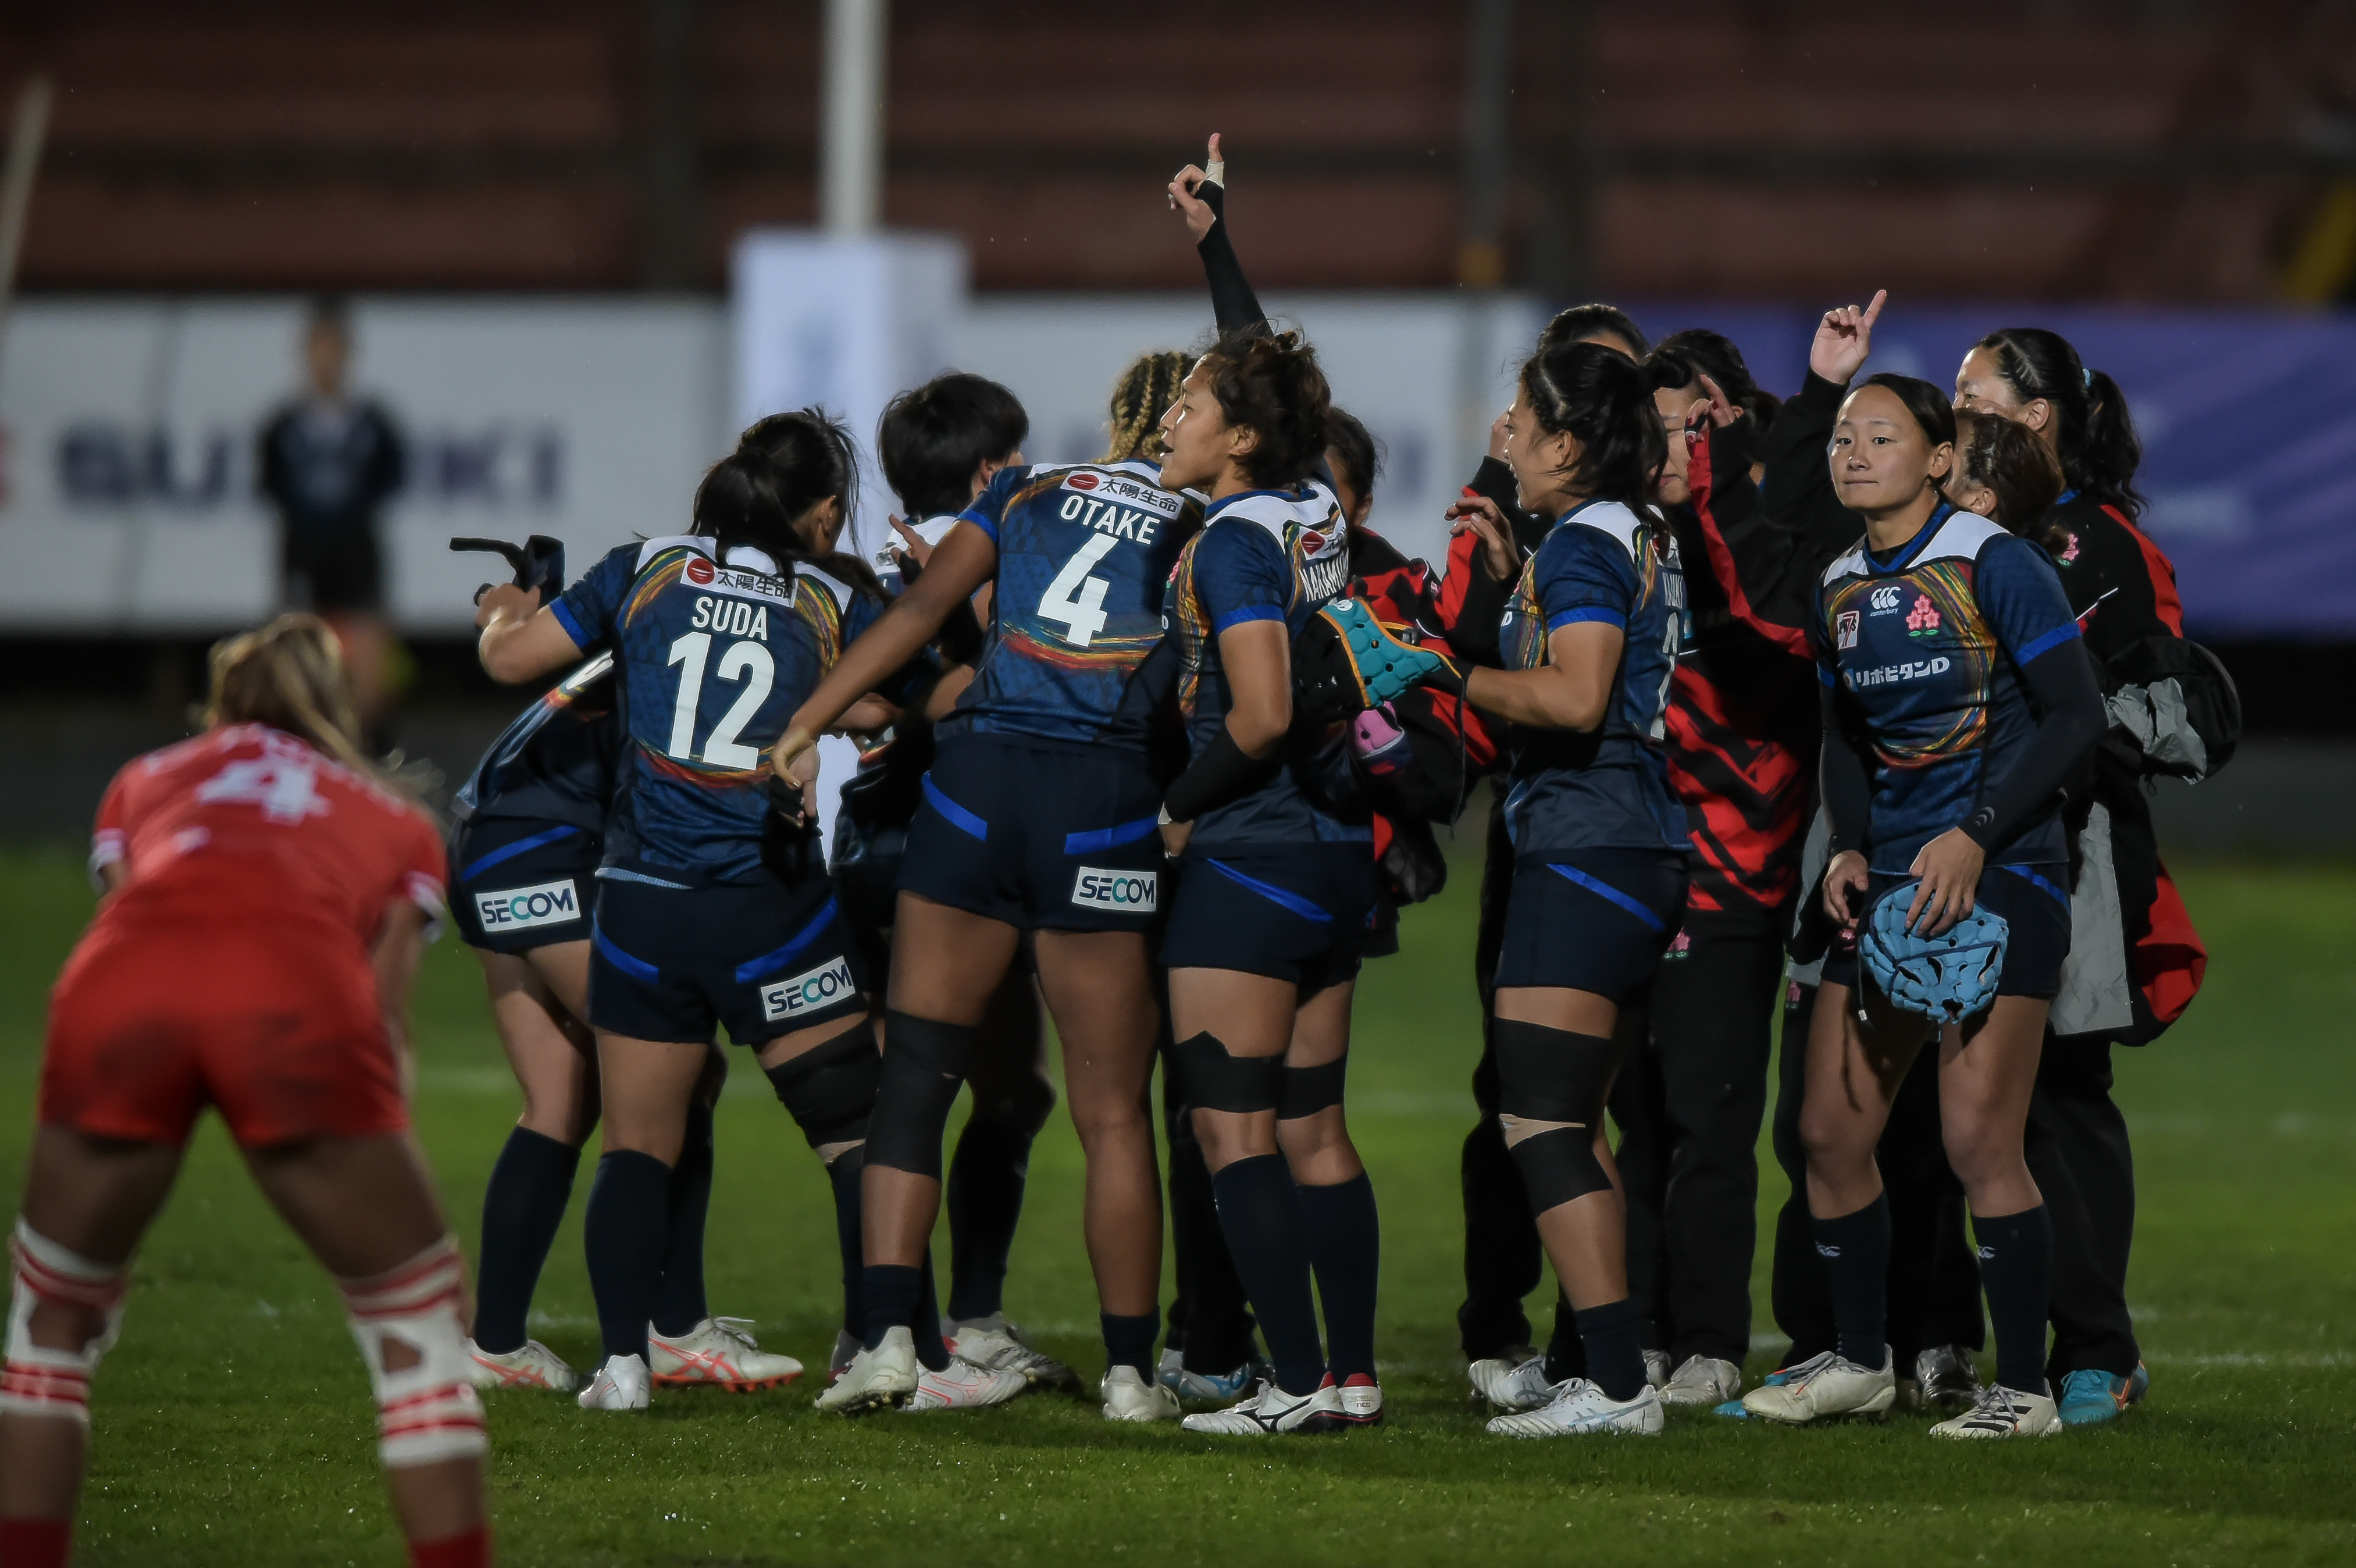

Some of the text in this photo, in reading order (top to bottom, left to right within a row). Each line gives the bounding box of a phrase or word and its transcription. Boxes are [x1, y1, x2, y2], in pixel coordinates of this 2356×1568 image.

[1100, 479, 1179, 512] 太陽生命
[1060, 495, 1160, 544] OTAKE
[1037, 532, 1119, 647] 4
[692, 596, 767, 640] SUDA
[1870, 608, 1899, 616] canterbury
[1856, 657, 1949, 686] リポビタンD
[668, 631, 775, 771] 12
[195, 756, 332, 826] 4
[482, 890, 575, 924] SECOM
[1079, 875, 1155, 904] SECOM
[768, 964, 853, 1015] SECOM
